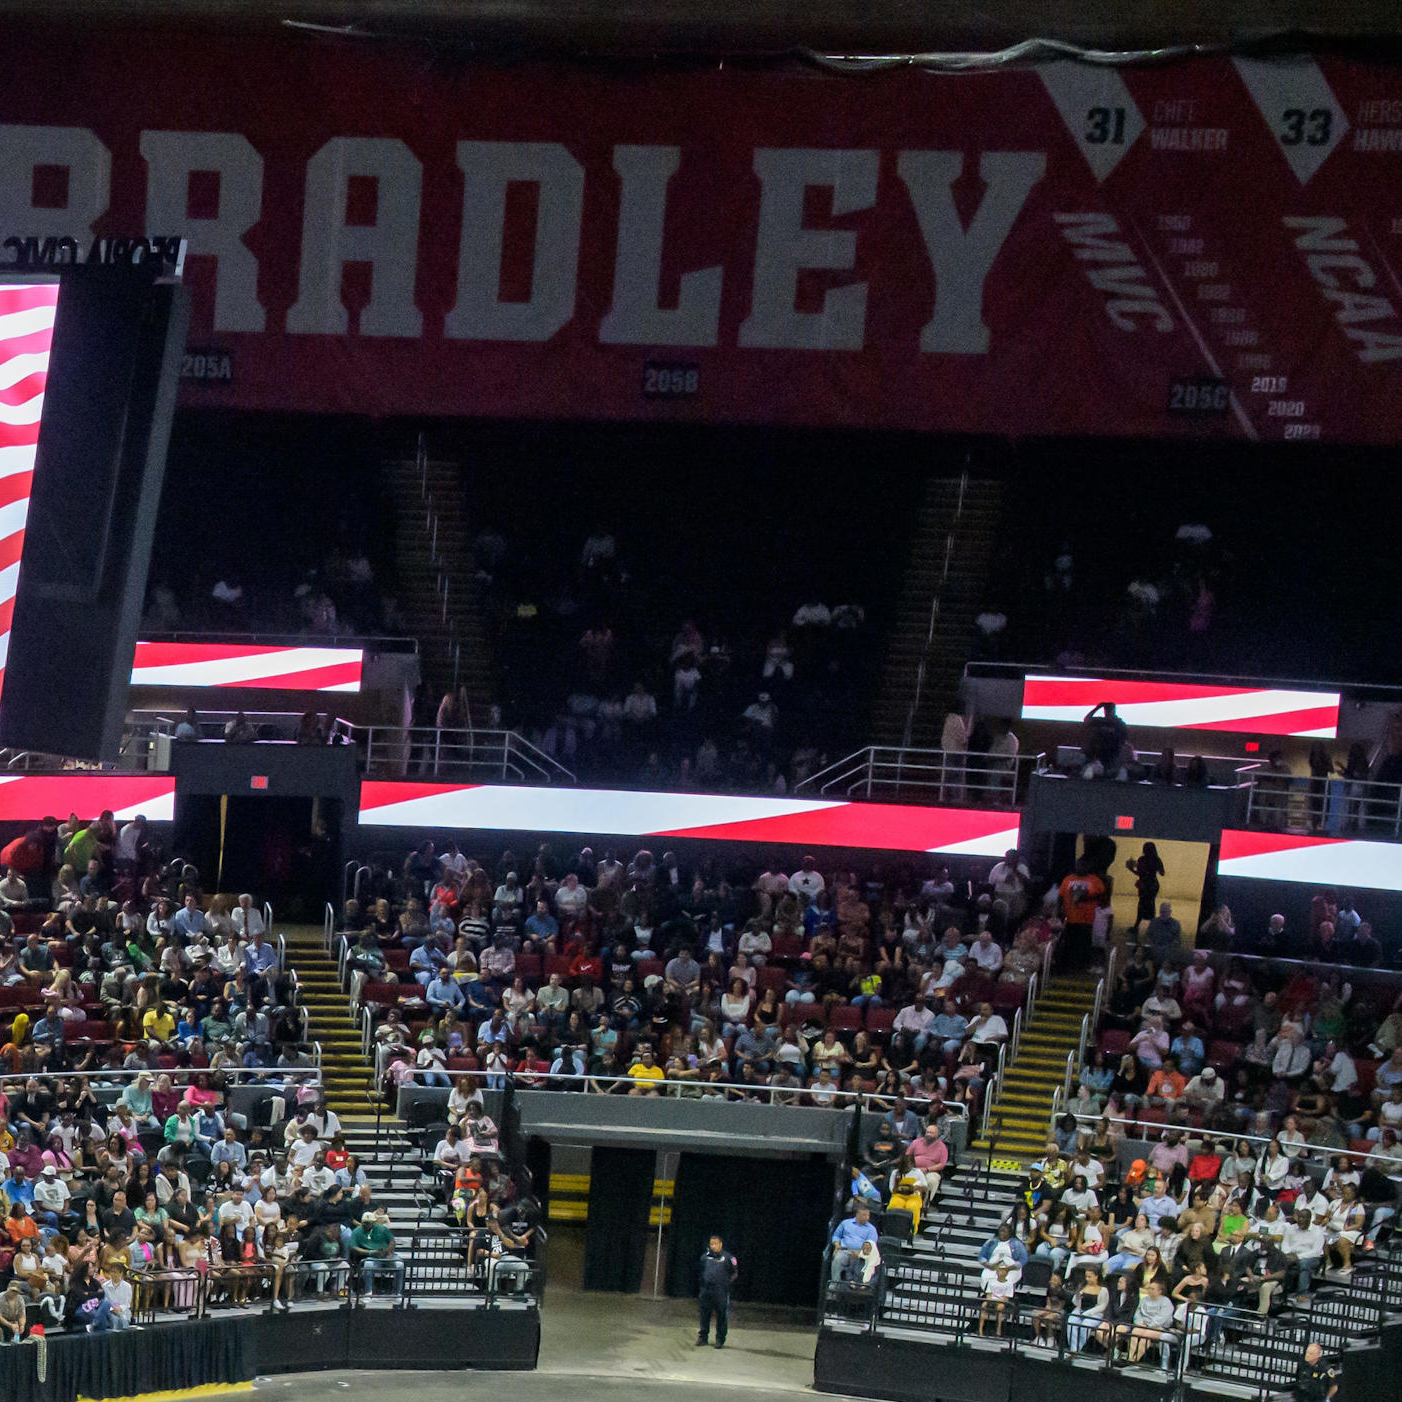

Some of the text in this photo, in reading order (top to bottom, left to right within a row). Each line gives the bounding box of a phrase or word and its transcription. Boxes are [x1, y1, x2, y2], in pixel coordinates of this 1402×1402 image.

[1085, 107, 1126, 144] 31
[1151, 128, 1229, 151] WALKER
[1281, 109, 1332, 146] 33
[1053, 213, 1174, 333] MVC
[1282, 216, 1402, 363] NCAA
[180, 354, 231, 379] 205A
[1268, 400, 1305, 417] 2020
